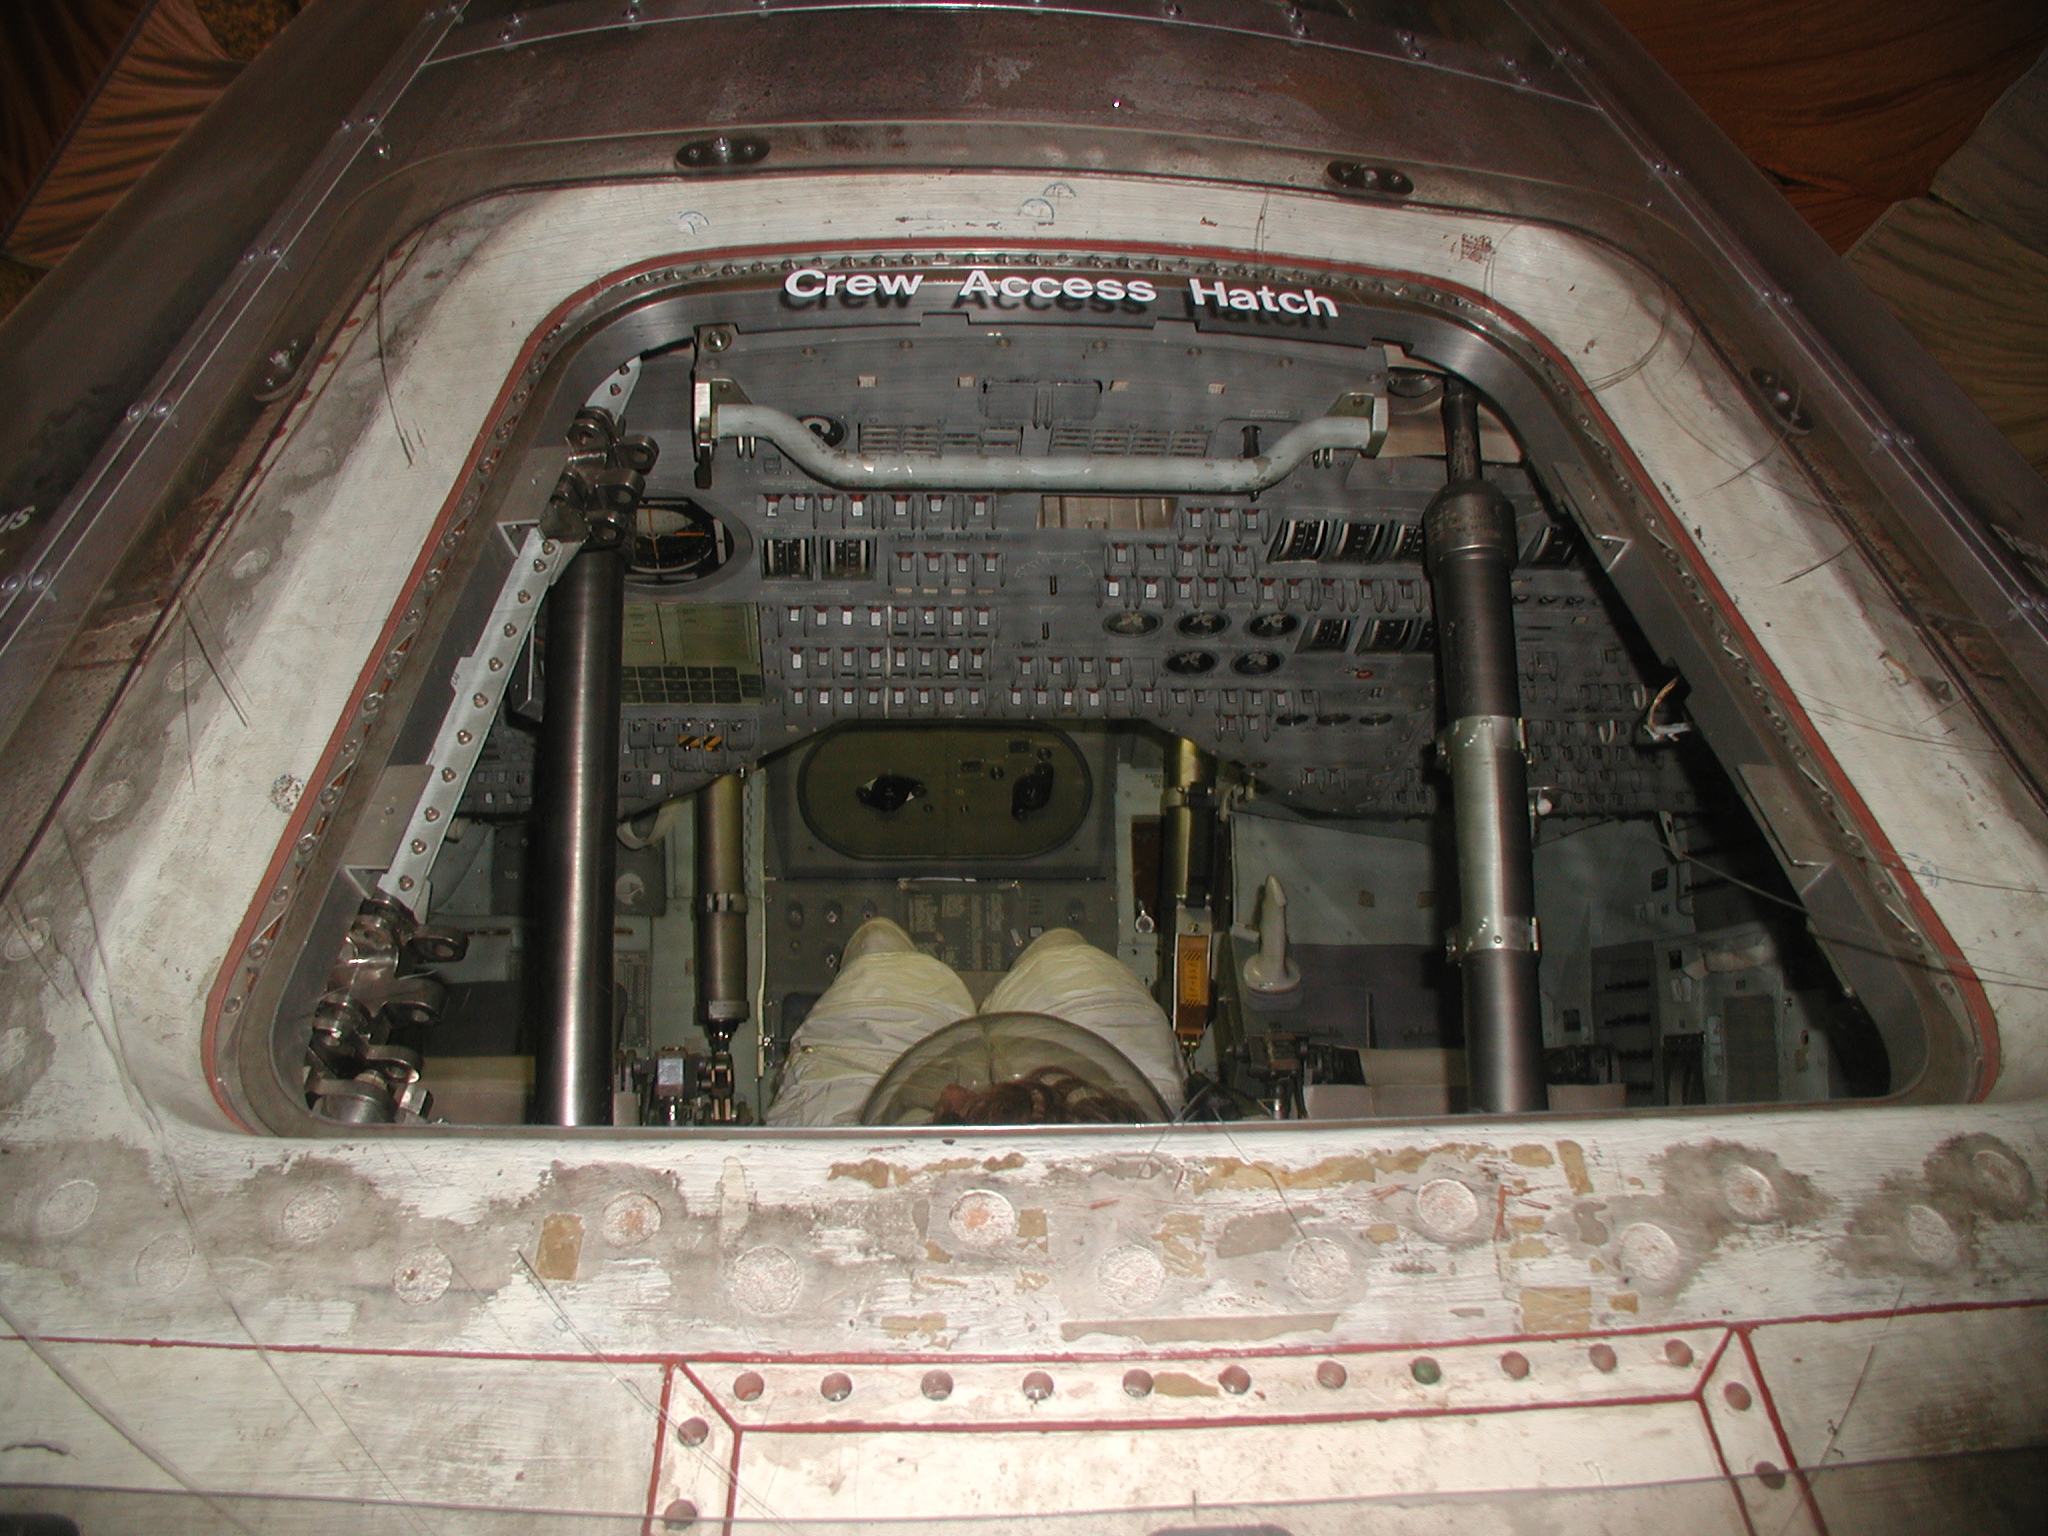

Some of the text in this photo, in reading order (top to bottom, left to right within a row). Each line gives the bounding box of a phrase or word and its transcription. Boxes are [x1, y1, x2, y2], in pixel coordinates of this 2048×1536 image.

[784, 268, 1339, 318] Crew Access Hatch
